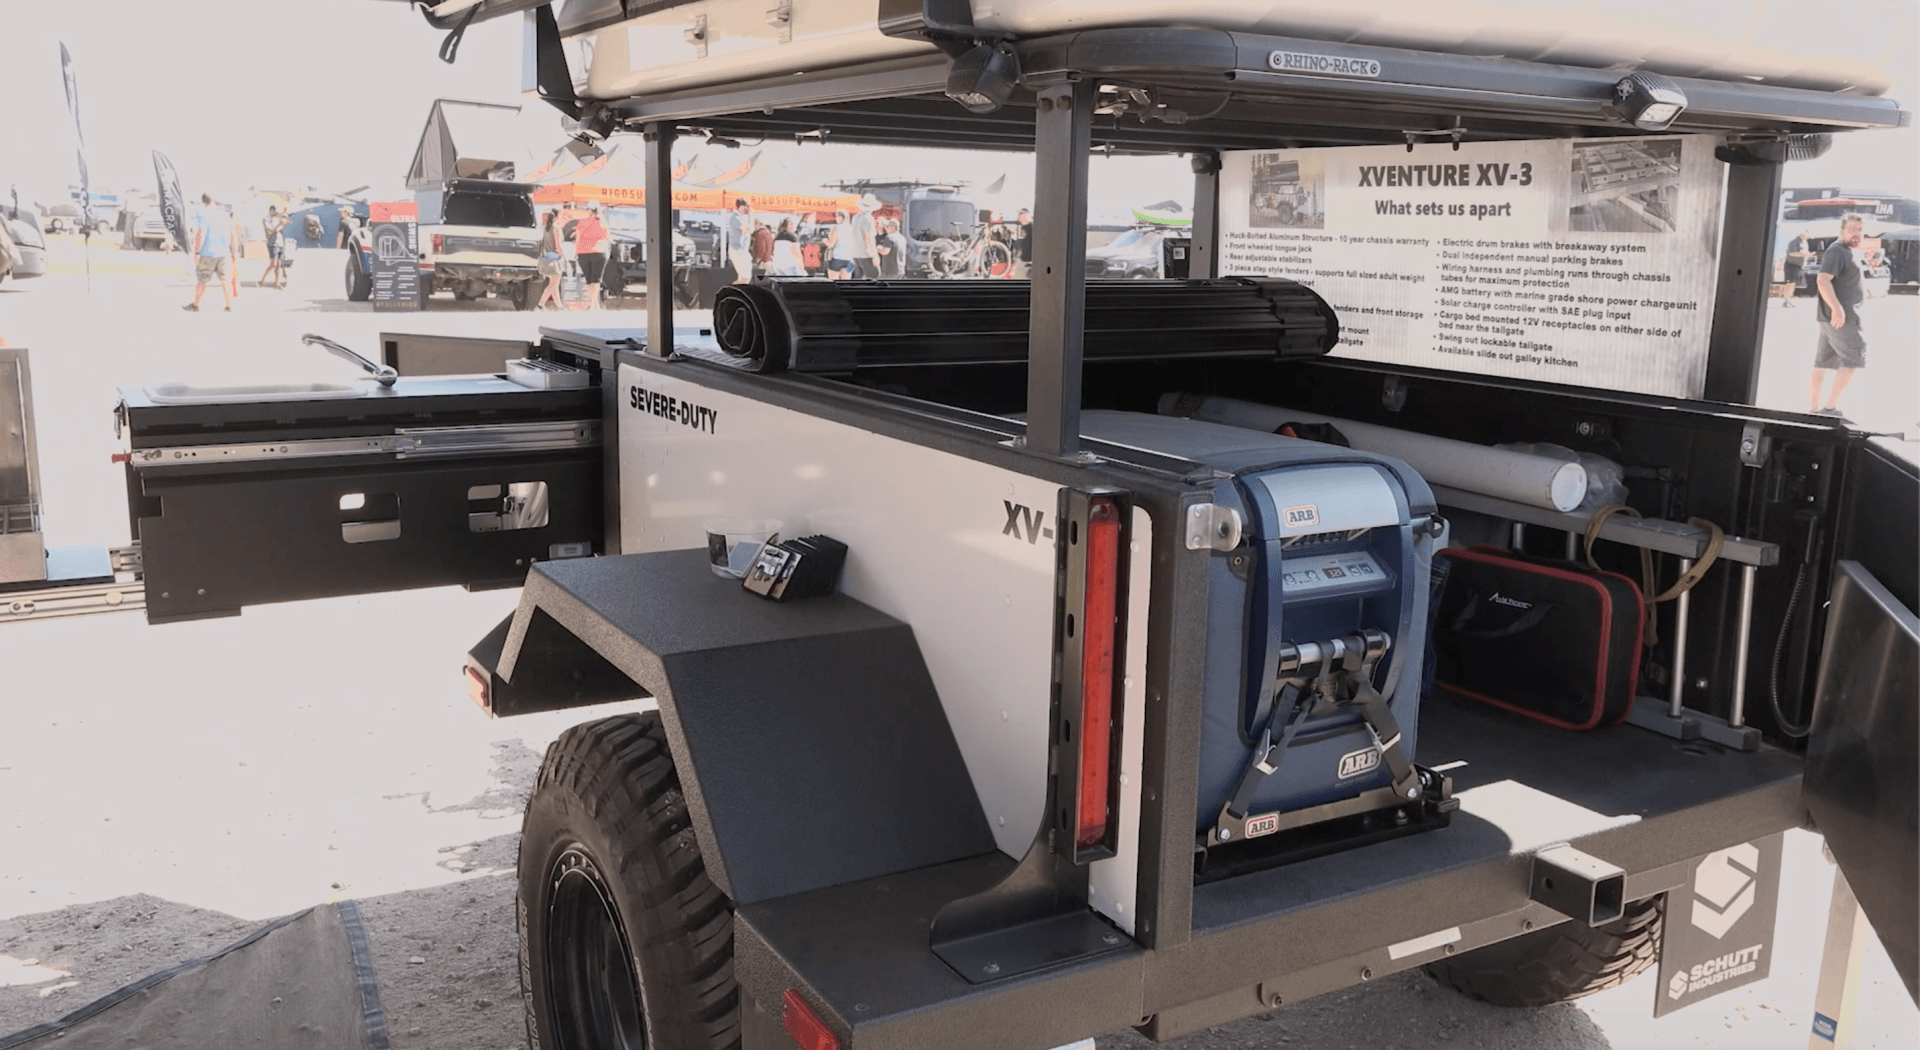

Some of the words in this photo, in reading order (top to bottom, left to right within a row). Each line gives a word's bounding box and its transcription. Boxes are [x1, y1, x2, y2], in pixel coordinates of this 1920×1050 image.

[1283, 53, 1368, 74] RHINO-RACK
[1358, 164, 1470, 187] XVENTURE
[1475, 162, 1533, 187] XV-3
[1374, 199, 1412, 216] What
[1415, 202, 1444, 216] sets
[1448, 204, 1465, 216] us
[1469, 202, 1512, 221] apart
[1229, 232, 1267, 240] Huck-Bolted
[1268, 233, 1300, 241] Aluminum
[1301, 234, 1333, 243] Structure
[1349, 236, 1365, 245] year
[1366, 236, 1394, 245] chassis
[1395, 238, 1430, 248] warranty
[1229, 242, 1246, 250] Front
[1247, 243, 1273, 251] wheeled
[1274, 244, 1297, 253] tongue
[1298, 245, 1312, 254] jack
[1442, 238, 1474, 247] Electric
[1476, 239, 1498, 248] drum
[1500, 240, 1530, 249] brakes
[1533, 241, 1553, 250] with
[1555, 241, 1608, 254] breakaway
[1610, 243, 1647, 254] system
[1245, 254, 1278, 263] adjustable
[1279, 256, 1312, 264] stabilizers
[1442, 251, 1460, 259] Dual
[1462, 251, 1514, 262] independent
[1517, 255, 1550, 263] manual
[1551, 255, 1588, 267] parking
[1590, 256, 1624, 266] brakes
[1234, 264, 1252, 273] piece
[1253, 265, 1267, 274] step
[1268, 266, 1283, 275] style
[1285, 267, 1309, 275] fenders
[1315, 269, 1344, 278] supports
[1346, 270, 1357, 278] full
[1359, 271, 1378, 279] sized
[1380, 272, 1398, 281] adult
[1399, 274, 1425, 284] weight
[1441, 263, 1467, 274] Wiring
[1469, 264, 1503, 274] harness
[1505, 267, 1521, 275] and
[1523, 267, 1565, 279] plumbing
[1567, 270, 1589, 278] runs
[1591, 270, 1630, 282] through
[1632, 272, 1671, 282] chassis
[1441, 274, 1463, 282] tubes
[1465, 274, 1477, 283] for
[1478, 276, 1520, 286] maximum
[1522, 279, 1570, 289] protection
[1440, 286, 1459, 295] AMG
[1461, 286, 1492, 298] battery
[1494, 289, 1513, 298] with
[1515, 291, 1546, 300] marine
[1548, 293, 1575, 303] grade
[1577, 294, 1605, 304] shore
[1606, 297, 1638, 307] power
[1375, 307, 1394, 316] front
[1395, 310, 1424, 320] storage
[1440, 298, 1462, 307] Solar
[1462, 300, 1491, 311] charge
[1493, 302, 1536, 313] controller
[1538, 305, 1559, 314] with
[1561, 306, 1580, 316] SAE
[1582, 309, 1603, 320] plug
[1606, 309, 1631, 320] input
[1347, 327, 1370, 335] mount
[1438, 320, 1453, 329] bed
[1455, 323, 1474, 331] near
[1476, 323, 1489, 332] the
[1491, 326, 1525, 337] tailgate
[1439, 310, 1463, 321] Cargo
[1465, 312, 1480, 321] bed
[1482, 315, 1520, 325] mounted
[1523, 317, 1540, 326] 12V
[1541, 320, 1597, 331] receptacles
[1614, 324, 1644, 335] either
[1646, 327, 1668, 337] side
[1670, 329, 1682, 338] of
[1438, 333, 1463, 344] Swing
[1464, 336, 1479, 344] out
[1480, 337, 1517, 348] lockable
[1519, 341, 1553, 352] tailgate
[1437, 345, 1475, 356] Available
[1476, 349, 1497, 359] slide
[1499, 352, 1514, 360] out
[1515, 354, 1542, 365] galley
[1544, 356, 1579, 368] kitchen
[630, 385, 718, 435] SEVERE-DUTY
[1002, 499, 1056, 545] XV-
[1289, 509, 1314, 523] ARB
[1341, 750, 1379, 775] ARB
[1250, 820, 1275, 834] ARB
[1690, 943, 1763, 982] SCHUTT
[1688, 961, 1756, 993] INDUSTRIES
